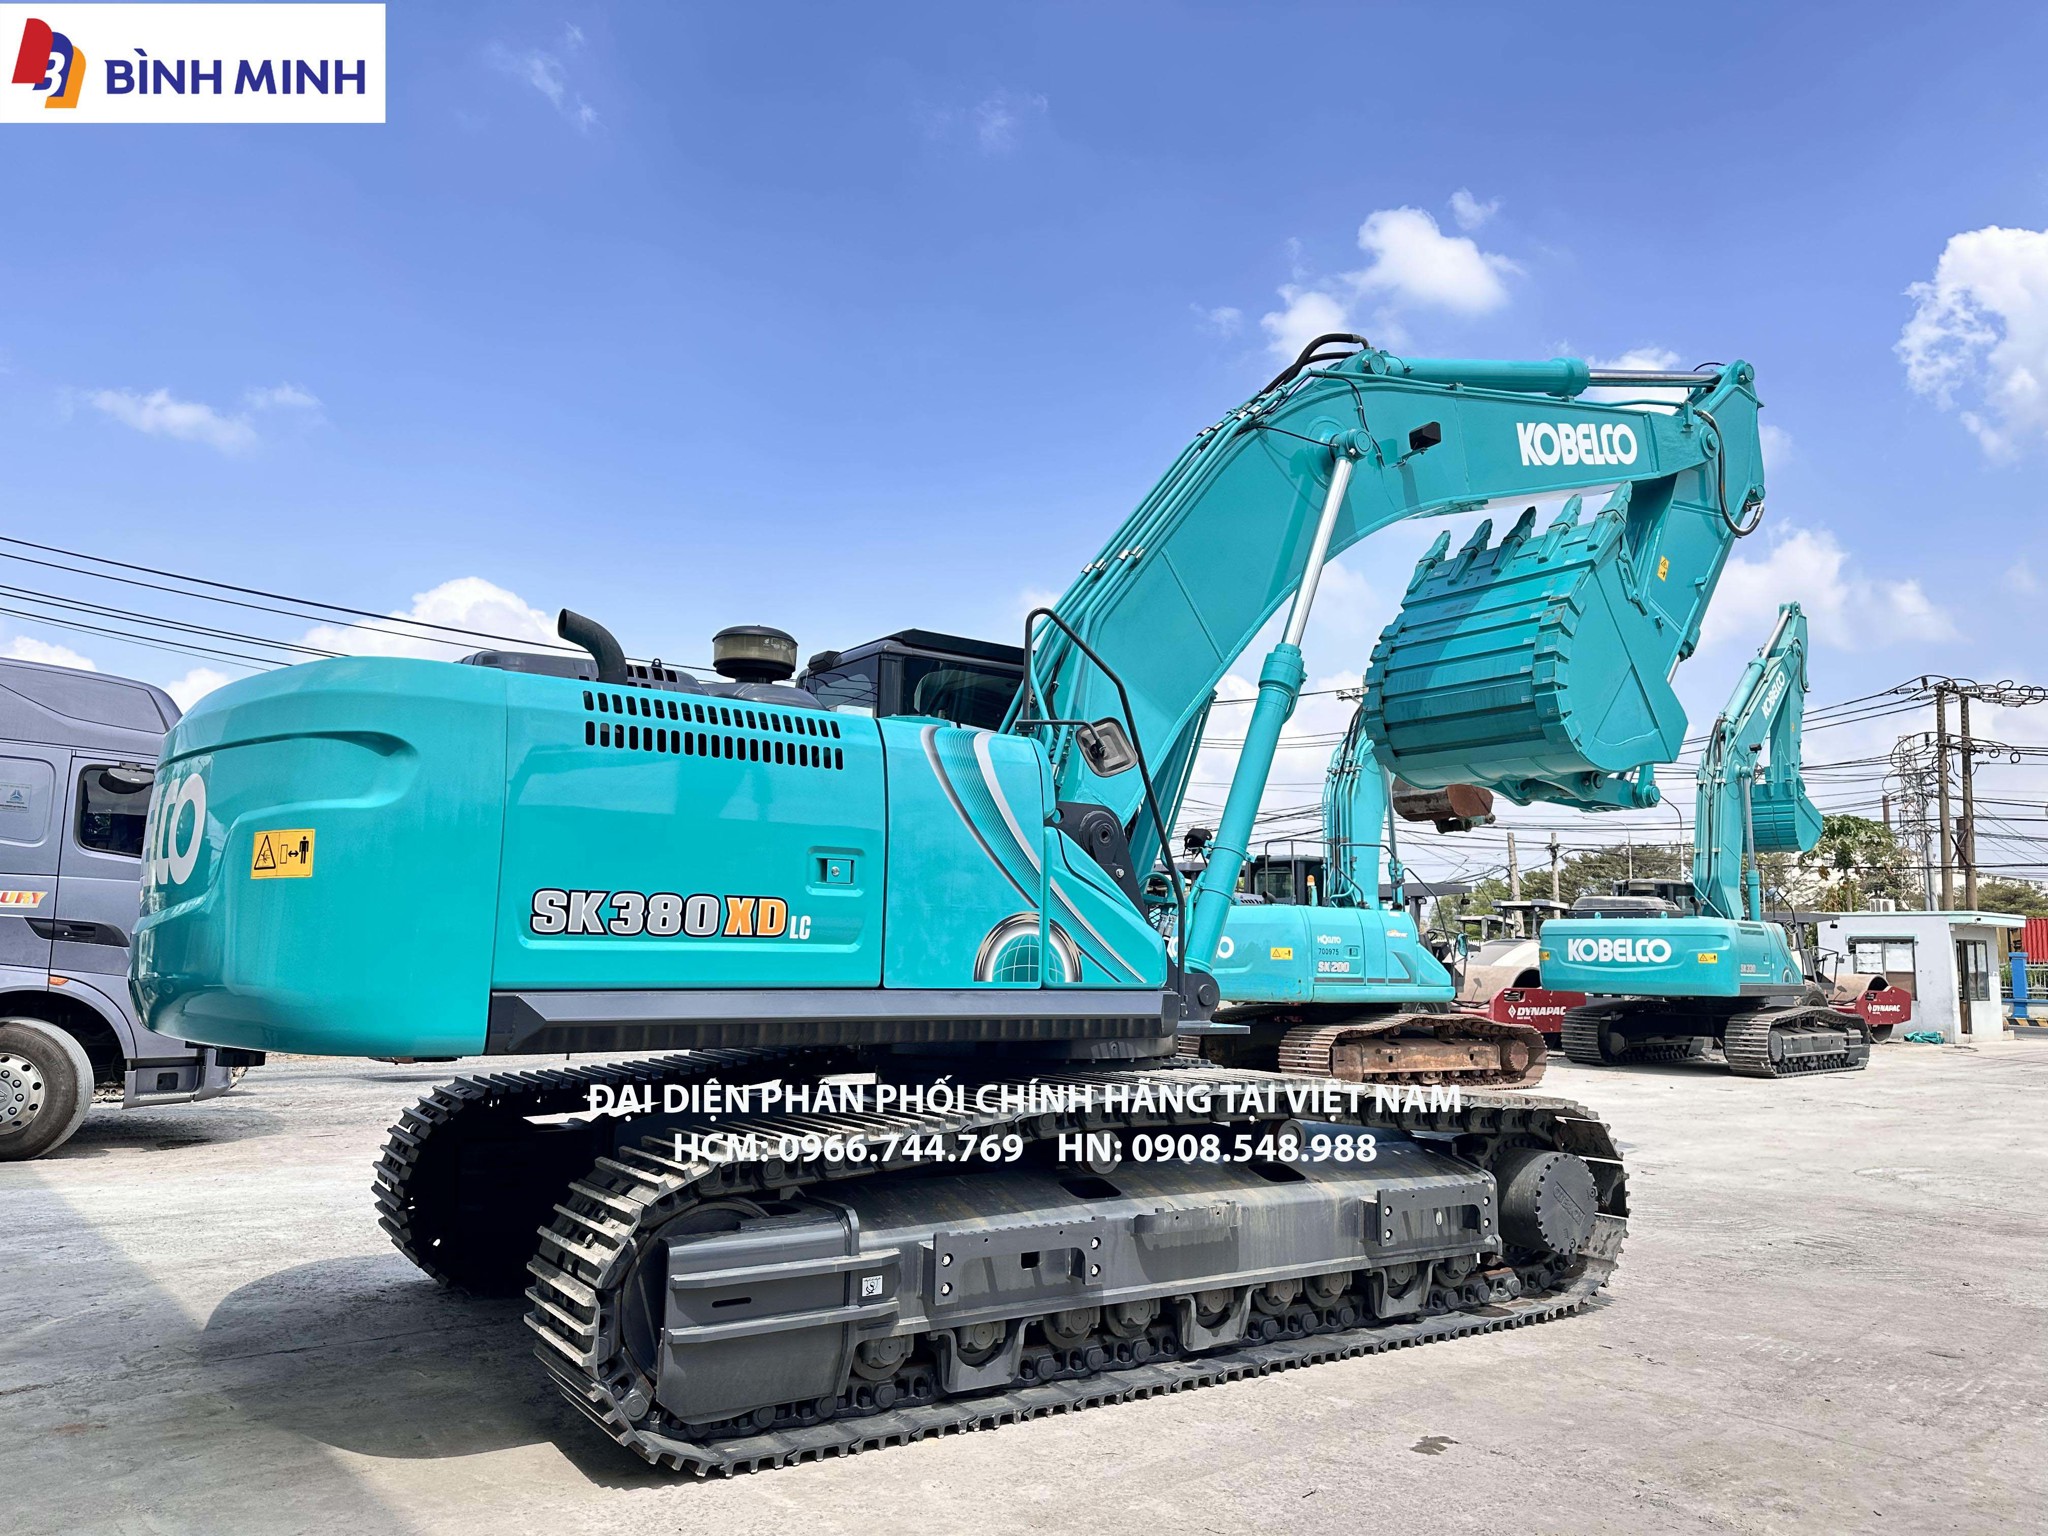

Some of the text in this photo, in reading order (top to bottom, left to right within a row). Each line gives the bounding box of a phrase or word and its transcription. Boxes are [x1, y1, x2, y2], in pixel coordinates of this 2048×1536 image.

[1516, 422, 1638, 466] KOBELCO
[789, 915, 811, 940] LC
[1567, 938, 1672, 963] KOBELCO
[1516, 1006, 1567, 1016] DYNAPAC
[1872, 1004, 1901, 1012] DYNAPAC
